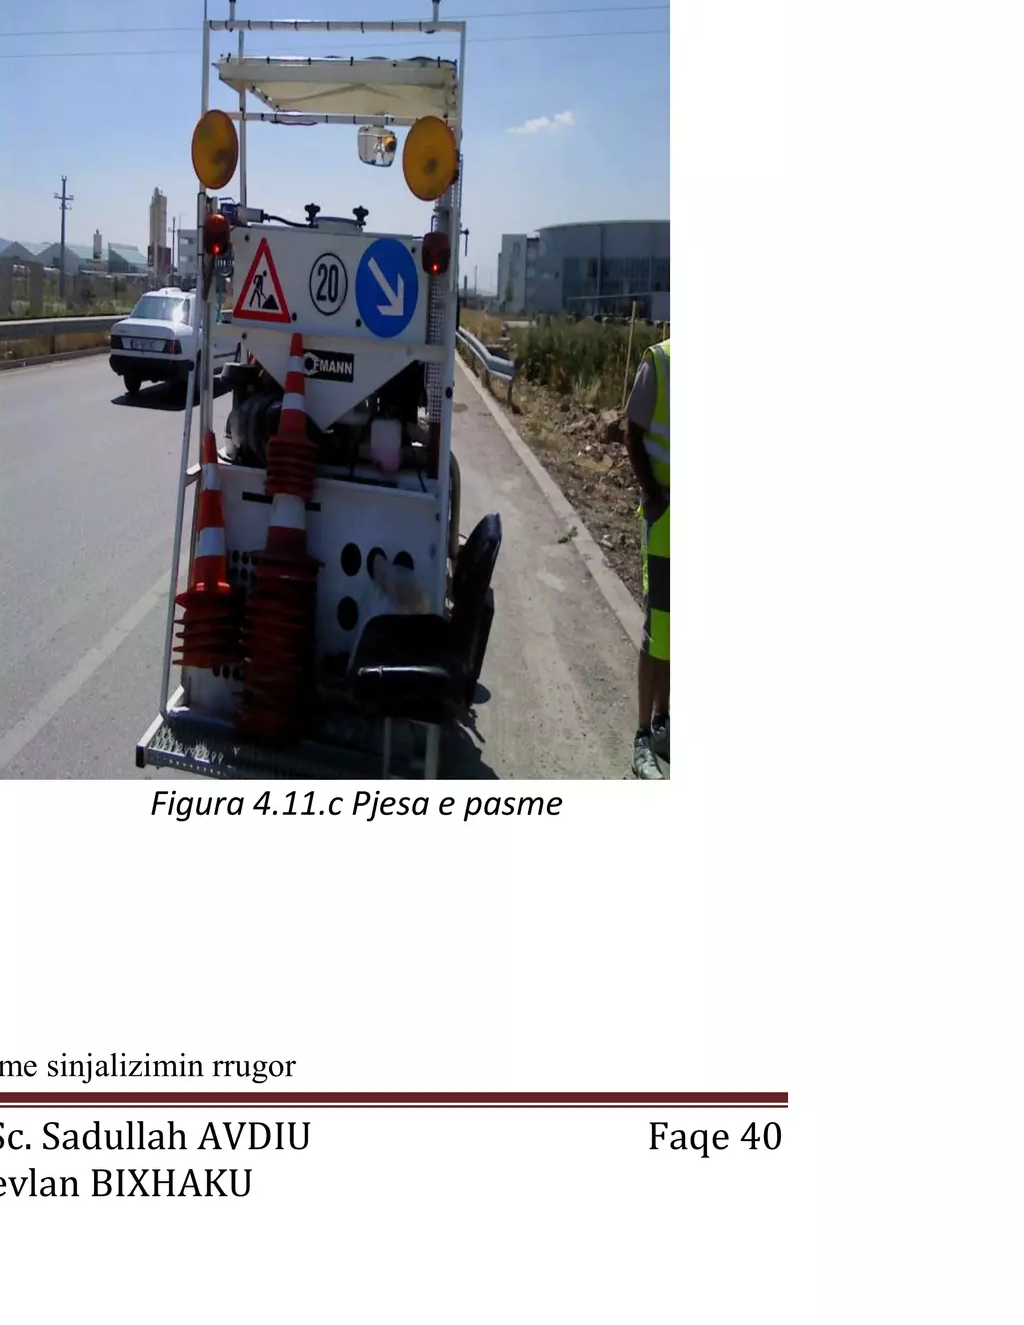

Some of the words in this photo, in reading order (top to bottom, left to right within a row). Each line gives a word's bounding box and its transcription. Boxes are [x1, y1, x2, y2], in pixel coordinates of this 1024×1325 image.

[316, 263, 339, 303] 20
[151, 791, 244, 821] Figura
[253, 791, 343, 815] 4.11.c
[353, 791, 429, 821] Pjesa
[439, 797, 455, 815] e
[464, 797, 562, 821] pasme
[48, 1053, 204, 1083] sinjalizimin
[213, 1061, 296, 1083] rrugor
[43, 1121, 187, 1150] Sadullah
[197, 1122, 310, 1150] AVDIU
[649, 1122, 729, 1158] Faqe
[741, 1122, 781, 1150] 40
[92, 1169, 252, 1197] BIXHAKU
